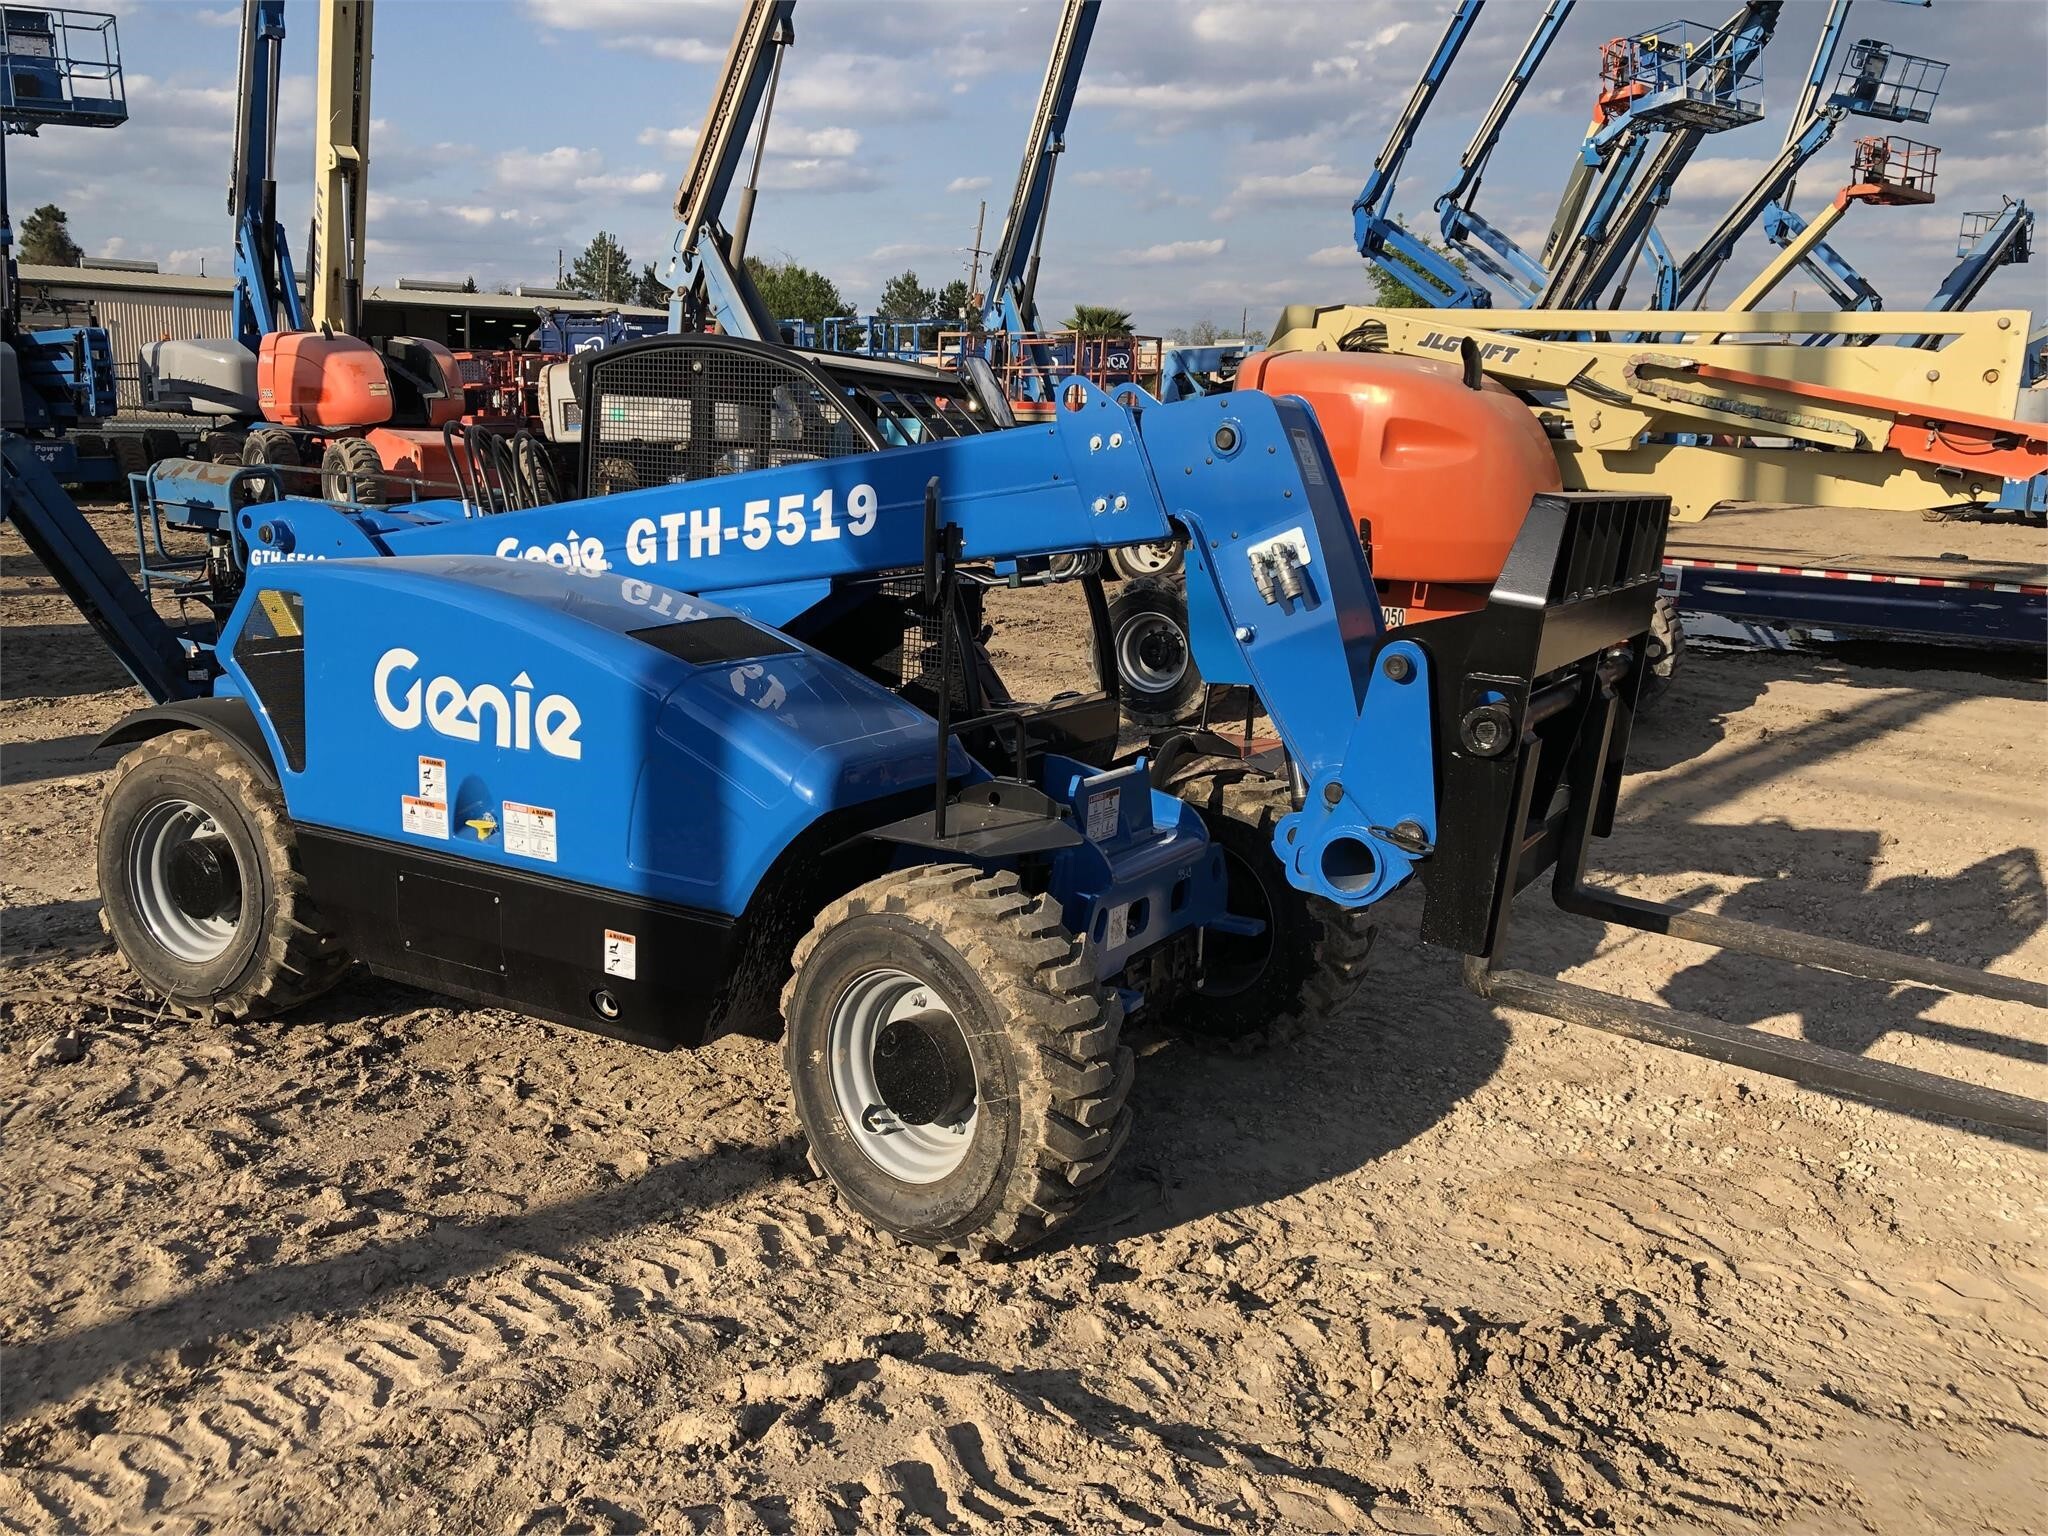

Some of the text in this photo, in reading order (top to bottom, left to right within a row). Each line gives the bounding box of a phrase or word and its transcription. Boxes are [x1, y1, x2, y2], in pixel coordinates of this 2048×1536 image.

[1547, 231, 1559, 256] JLG
[1417, 332, 1521, 363] JLG IFT
[626, 484, 878, 567] GTH-5519
[374, 647, 582, 760] Genie
